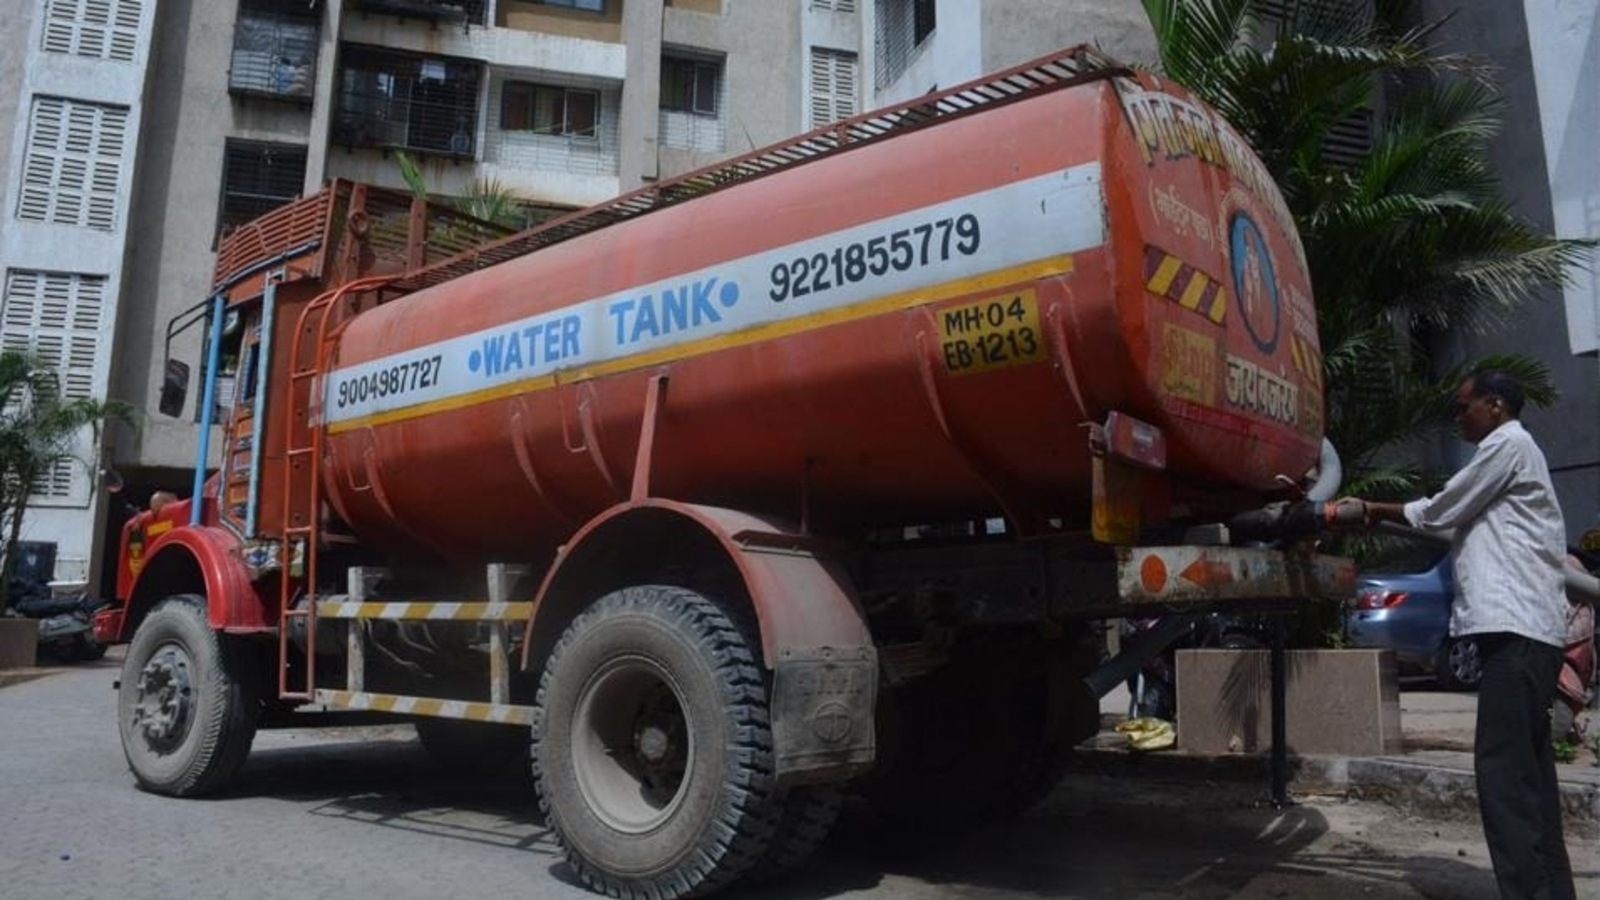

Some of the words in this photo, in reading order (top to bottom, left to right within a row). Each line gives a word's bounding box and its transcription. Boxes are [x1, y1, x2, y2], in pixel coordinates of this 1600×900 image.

[769, 213, 981, 303] 9221855779
[483, 314, 582, 377] WATER
[609, 277, 722, 345] TANK
[337, 354, 443, 409] 9004987727
